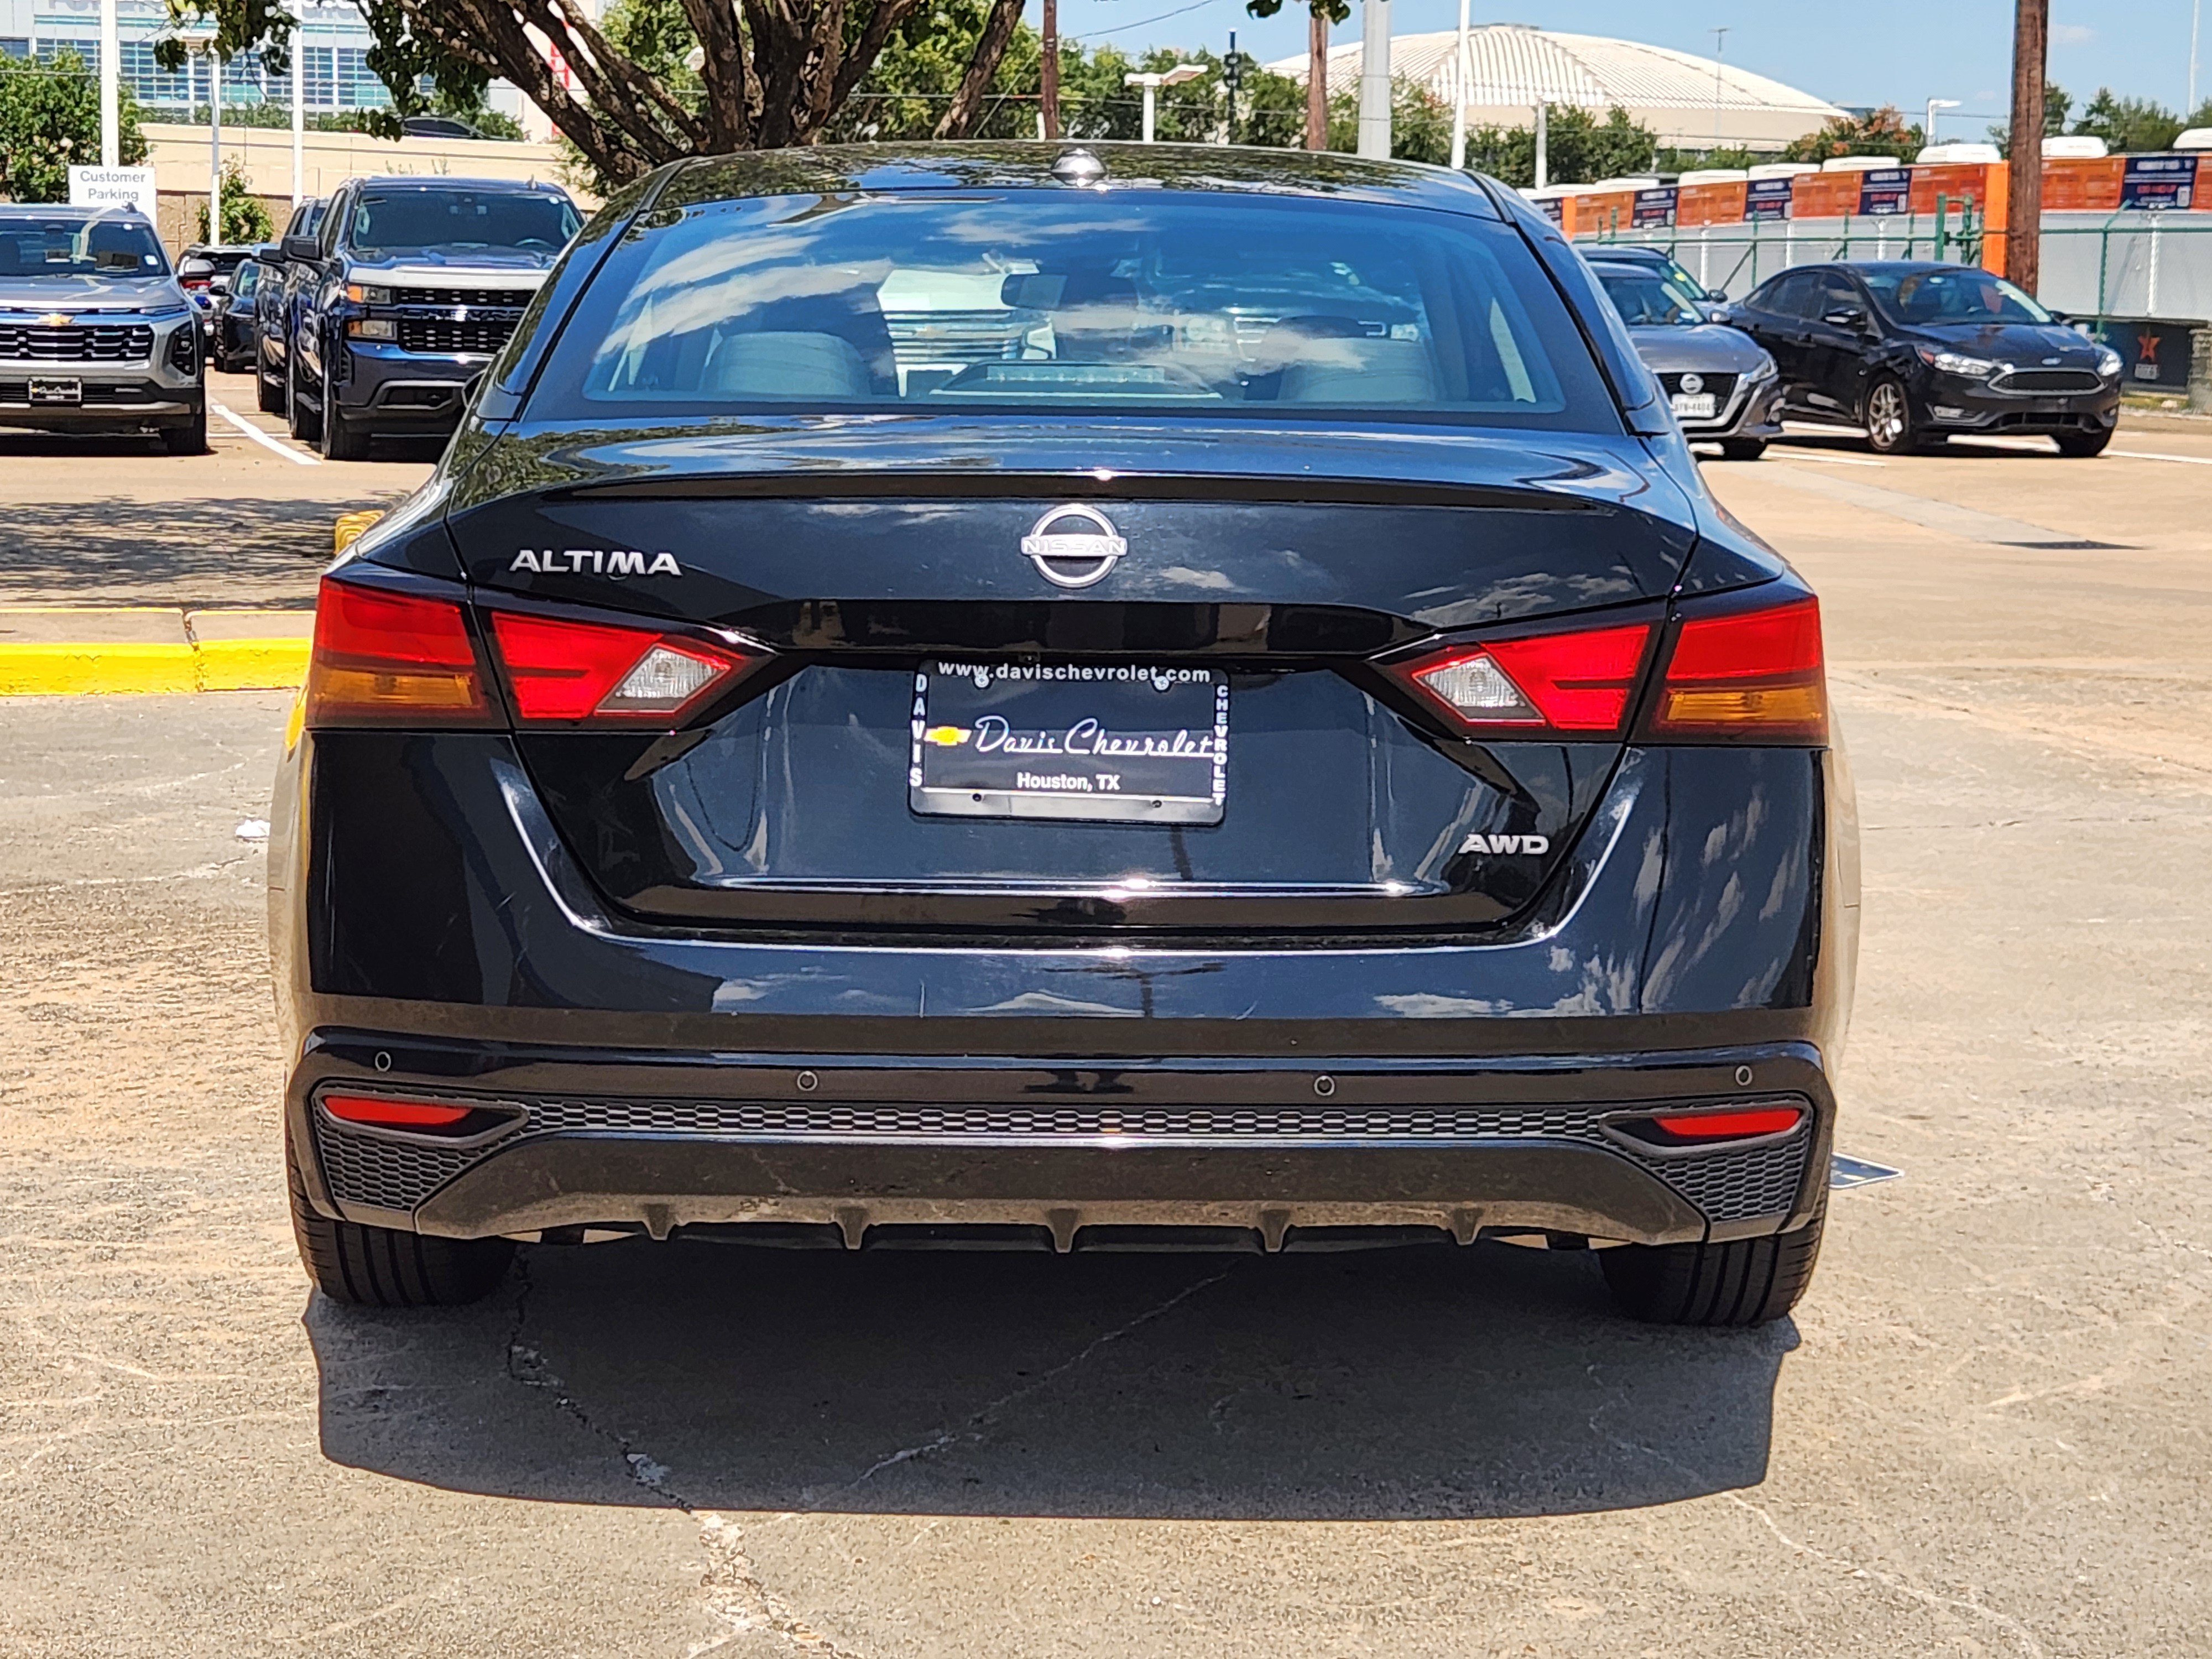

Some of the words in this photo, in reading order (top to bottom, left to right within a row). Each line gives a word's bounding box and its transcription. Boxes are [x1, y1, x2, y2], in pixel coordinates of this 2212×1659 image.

[80, 170, 146, 183] Customer
[88, 188, 139, 202] Parking
[1022, 539, 1126, 554] NISSAN
[509, 550, 683, 576] ALTIMA
[938, 662, 1211, 683] www.davischevrolet.com
[909, 674, 927, 787] DAVIS
[975, 715, 1063, 753] Davis
[1065, 718, 1214, 758] Chevrolet
[1212, 685, 1229, 806] CHEVROLET
[1016, 772, 1093, 792] Houston,
[1095, 774, 1121, 791] TX
[1458, 834, 1549, 854] AWD
